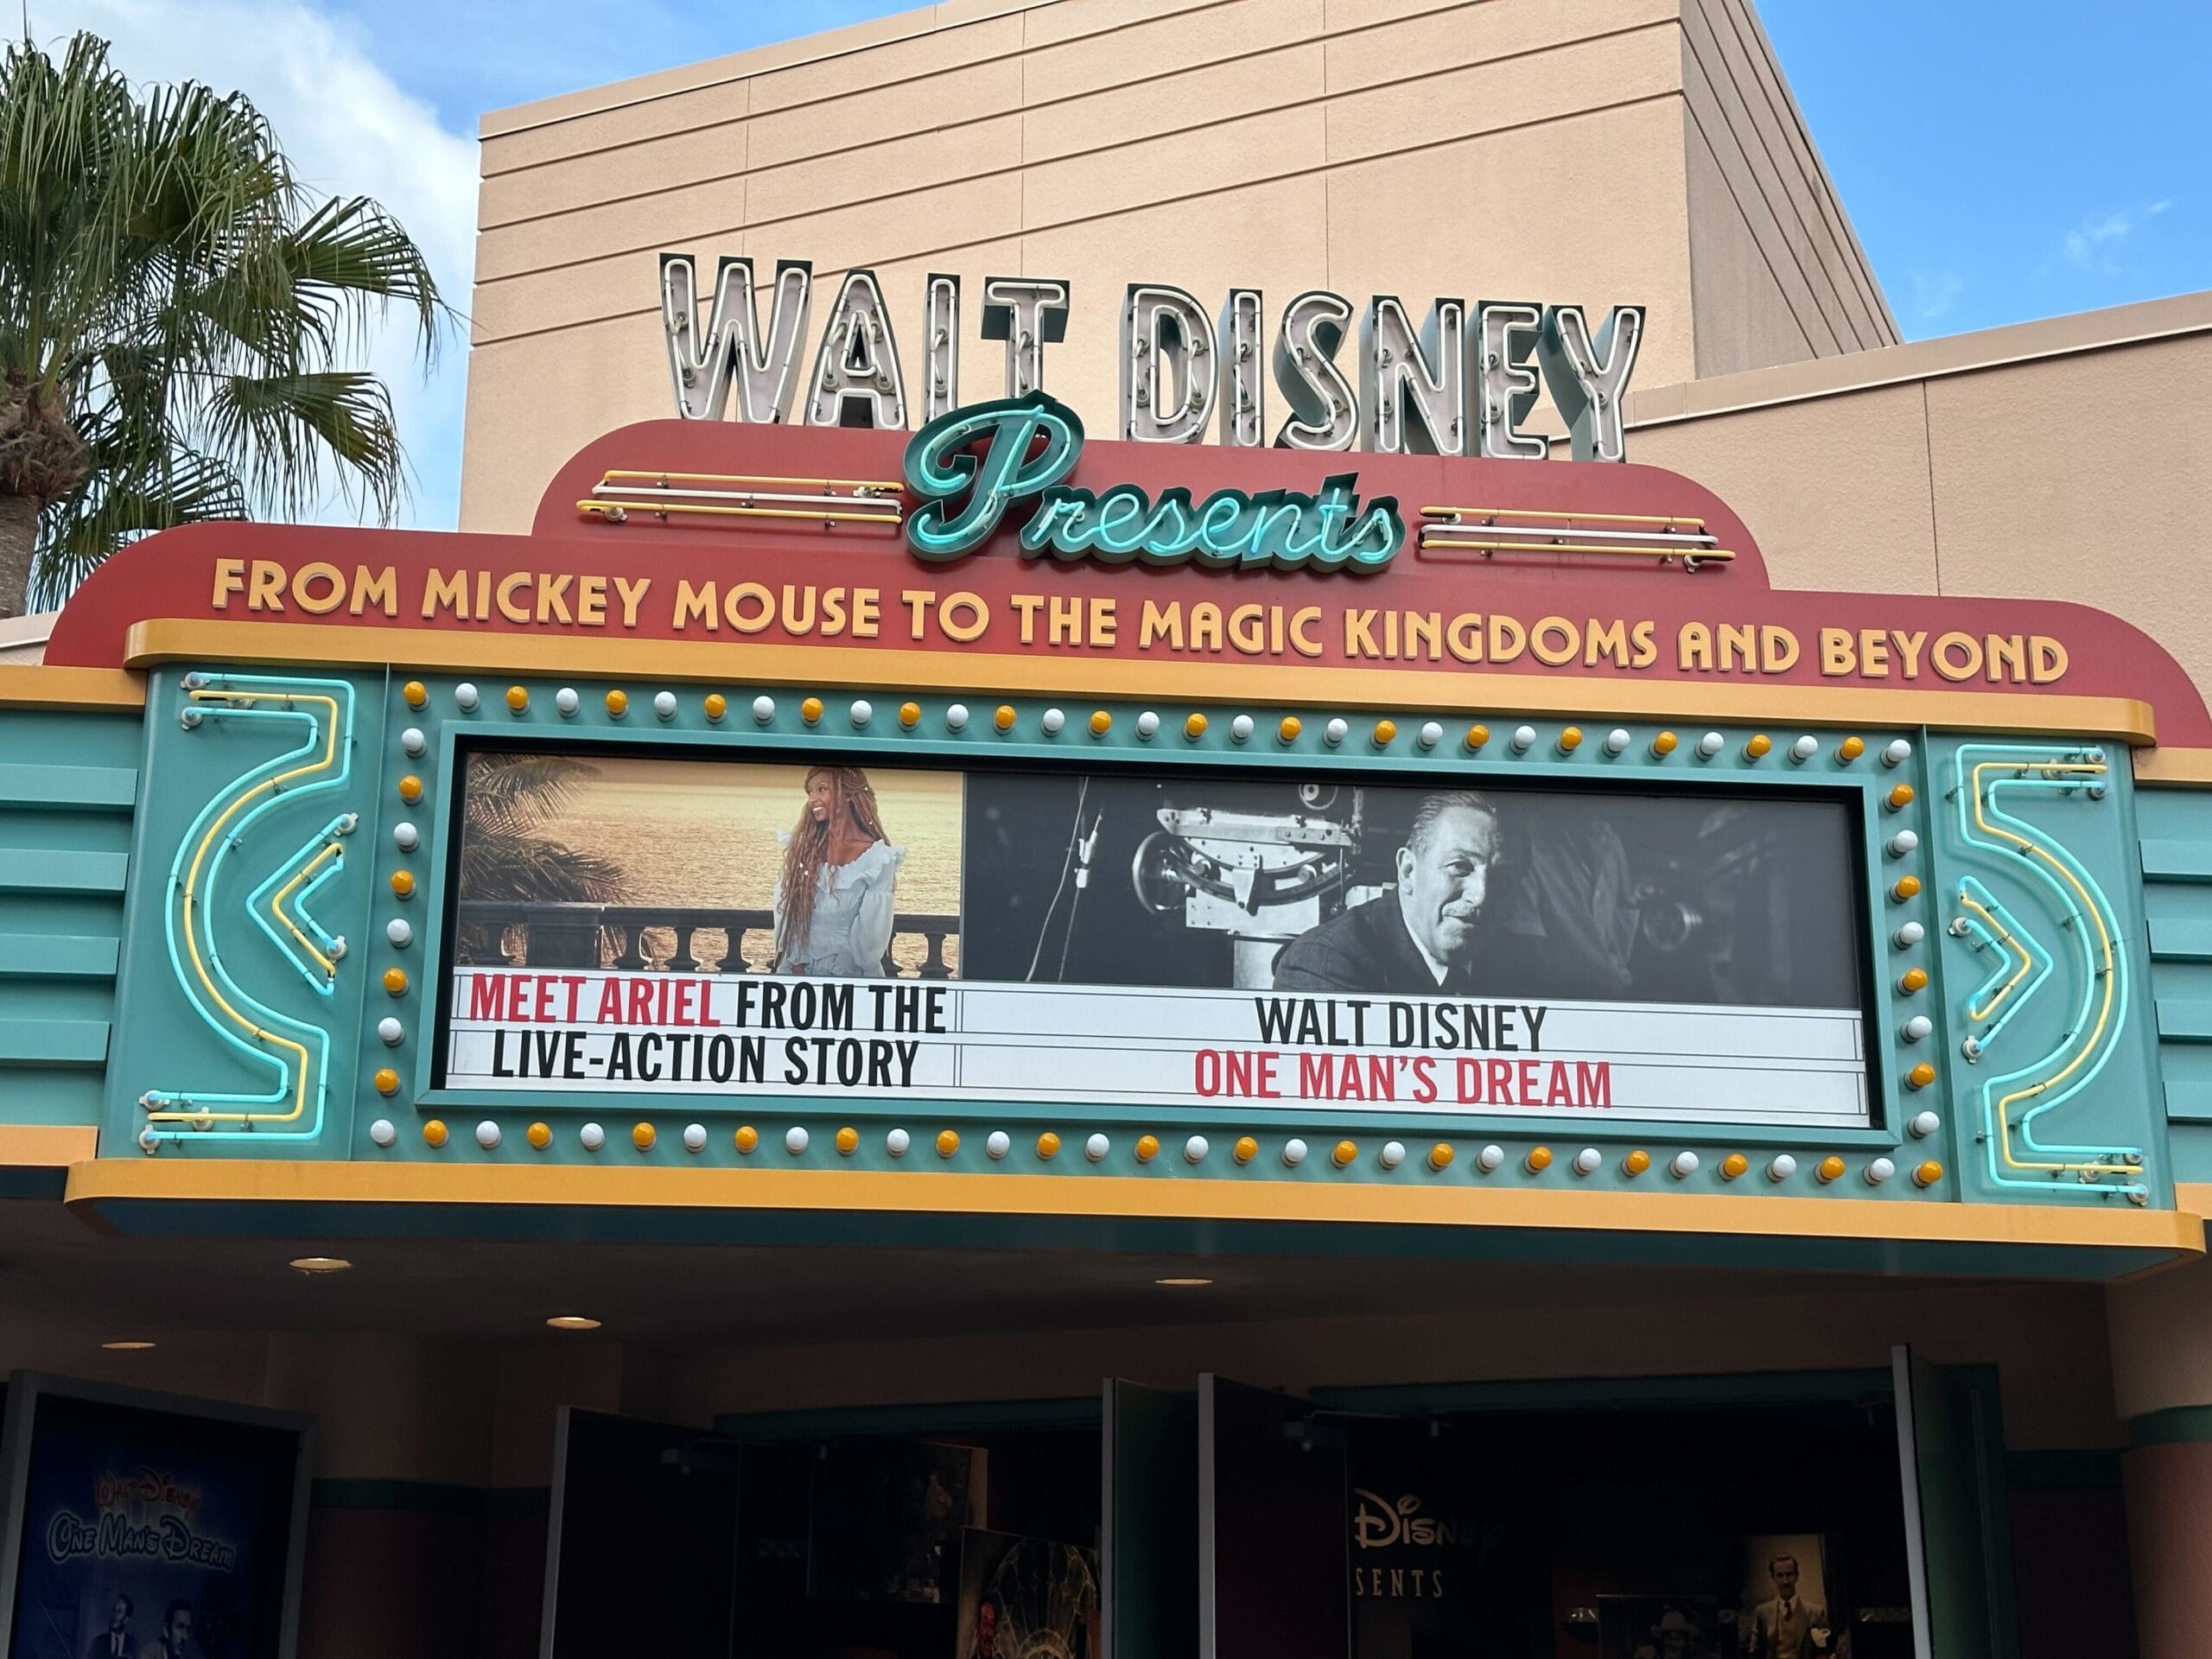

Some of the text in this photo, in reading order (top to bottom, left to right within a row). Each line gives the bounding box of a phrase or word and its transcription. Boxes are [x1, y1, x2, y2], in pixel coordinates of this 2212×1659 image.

[1121, 283, 1645, 463] DISNEY
[904, 390, 1407, 574] Presents
[212, 558, 2069, 683] FROM MICKEY MOUSE TO THE MAGIC KINGDOMS AND BEYOND
[469, 973, 947, 1034] MEET ARIEL FROM THE
[1255, 996, 1548, 1052] WALT DISNEY
[492, 1029, 920, 1088] LIVE-ACTION STORY
[1194, 1048, 1611, 1108] ONE MAN'S DREAM
[1354, 1567, 1446, 1599] SENTS
